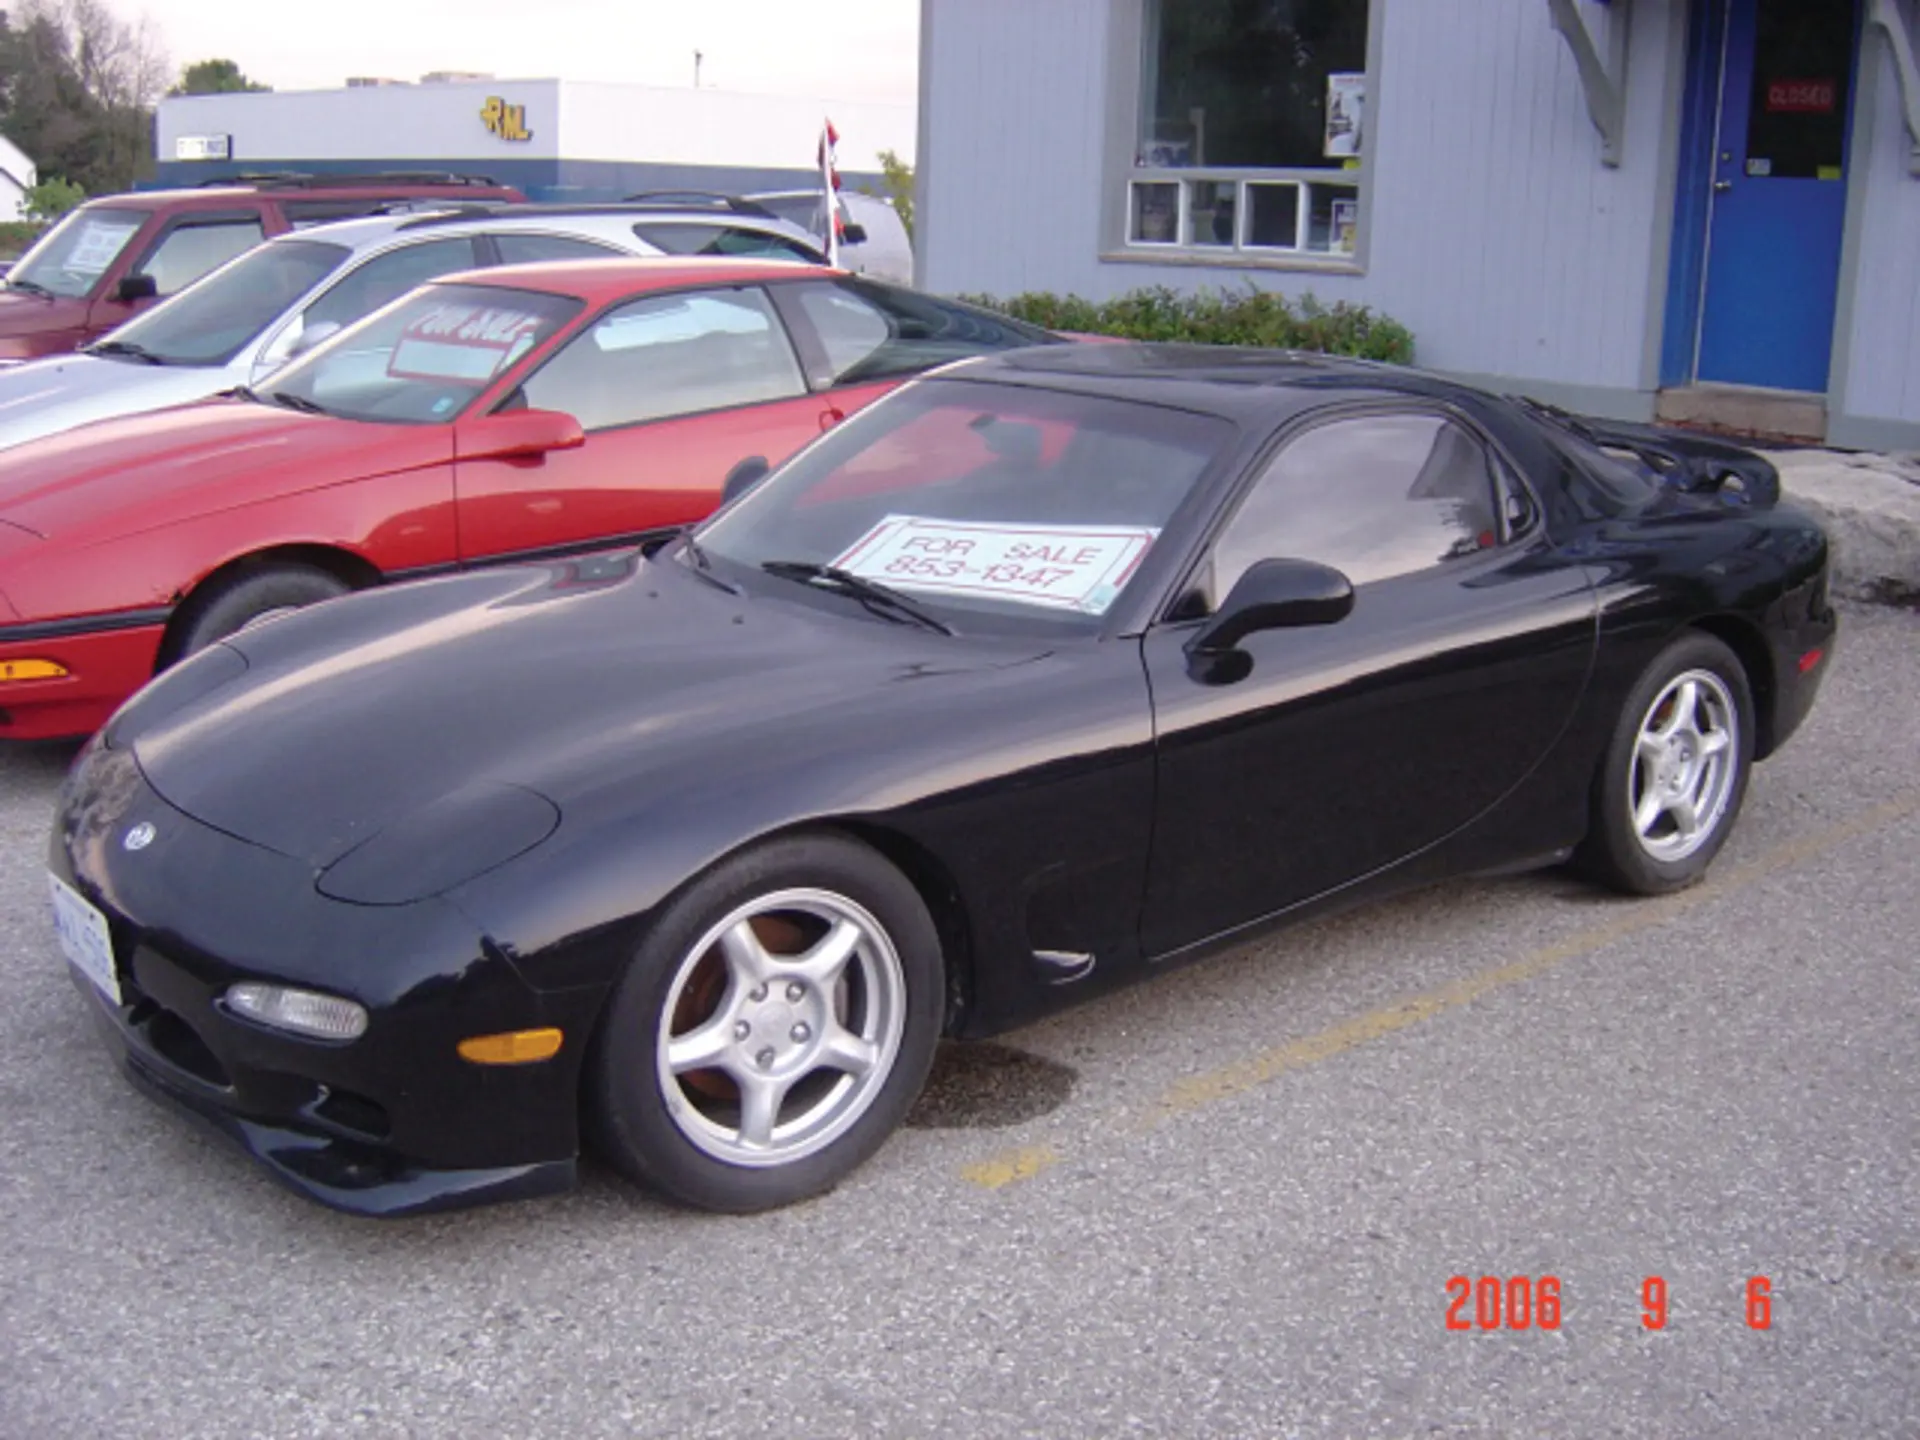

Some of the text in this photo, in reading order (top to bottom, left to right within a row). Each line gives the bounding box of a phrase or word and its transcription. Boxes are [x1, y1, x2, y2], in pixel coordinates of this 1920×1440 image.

[1768, 84, 1833, 106] CLOSED
[900, 535, 1102, 566] FOR SALE
[884, 554, 1075, 589] 853-1347
